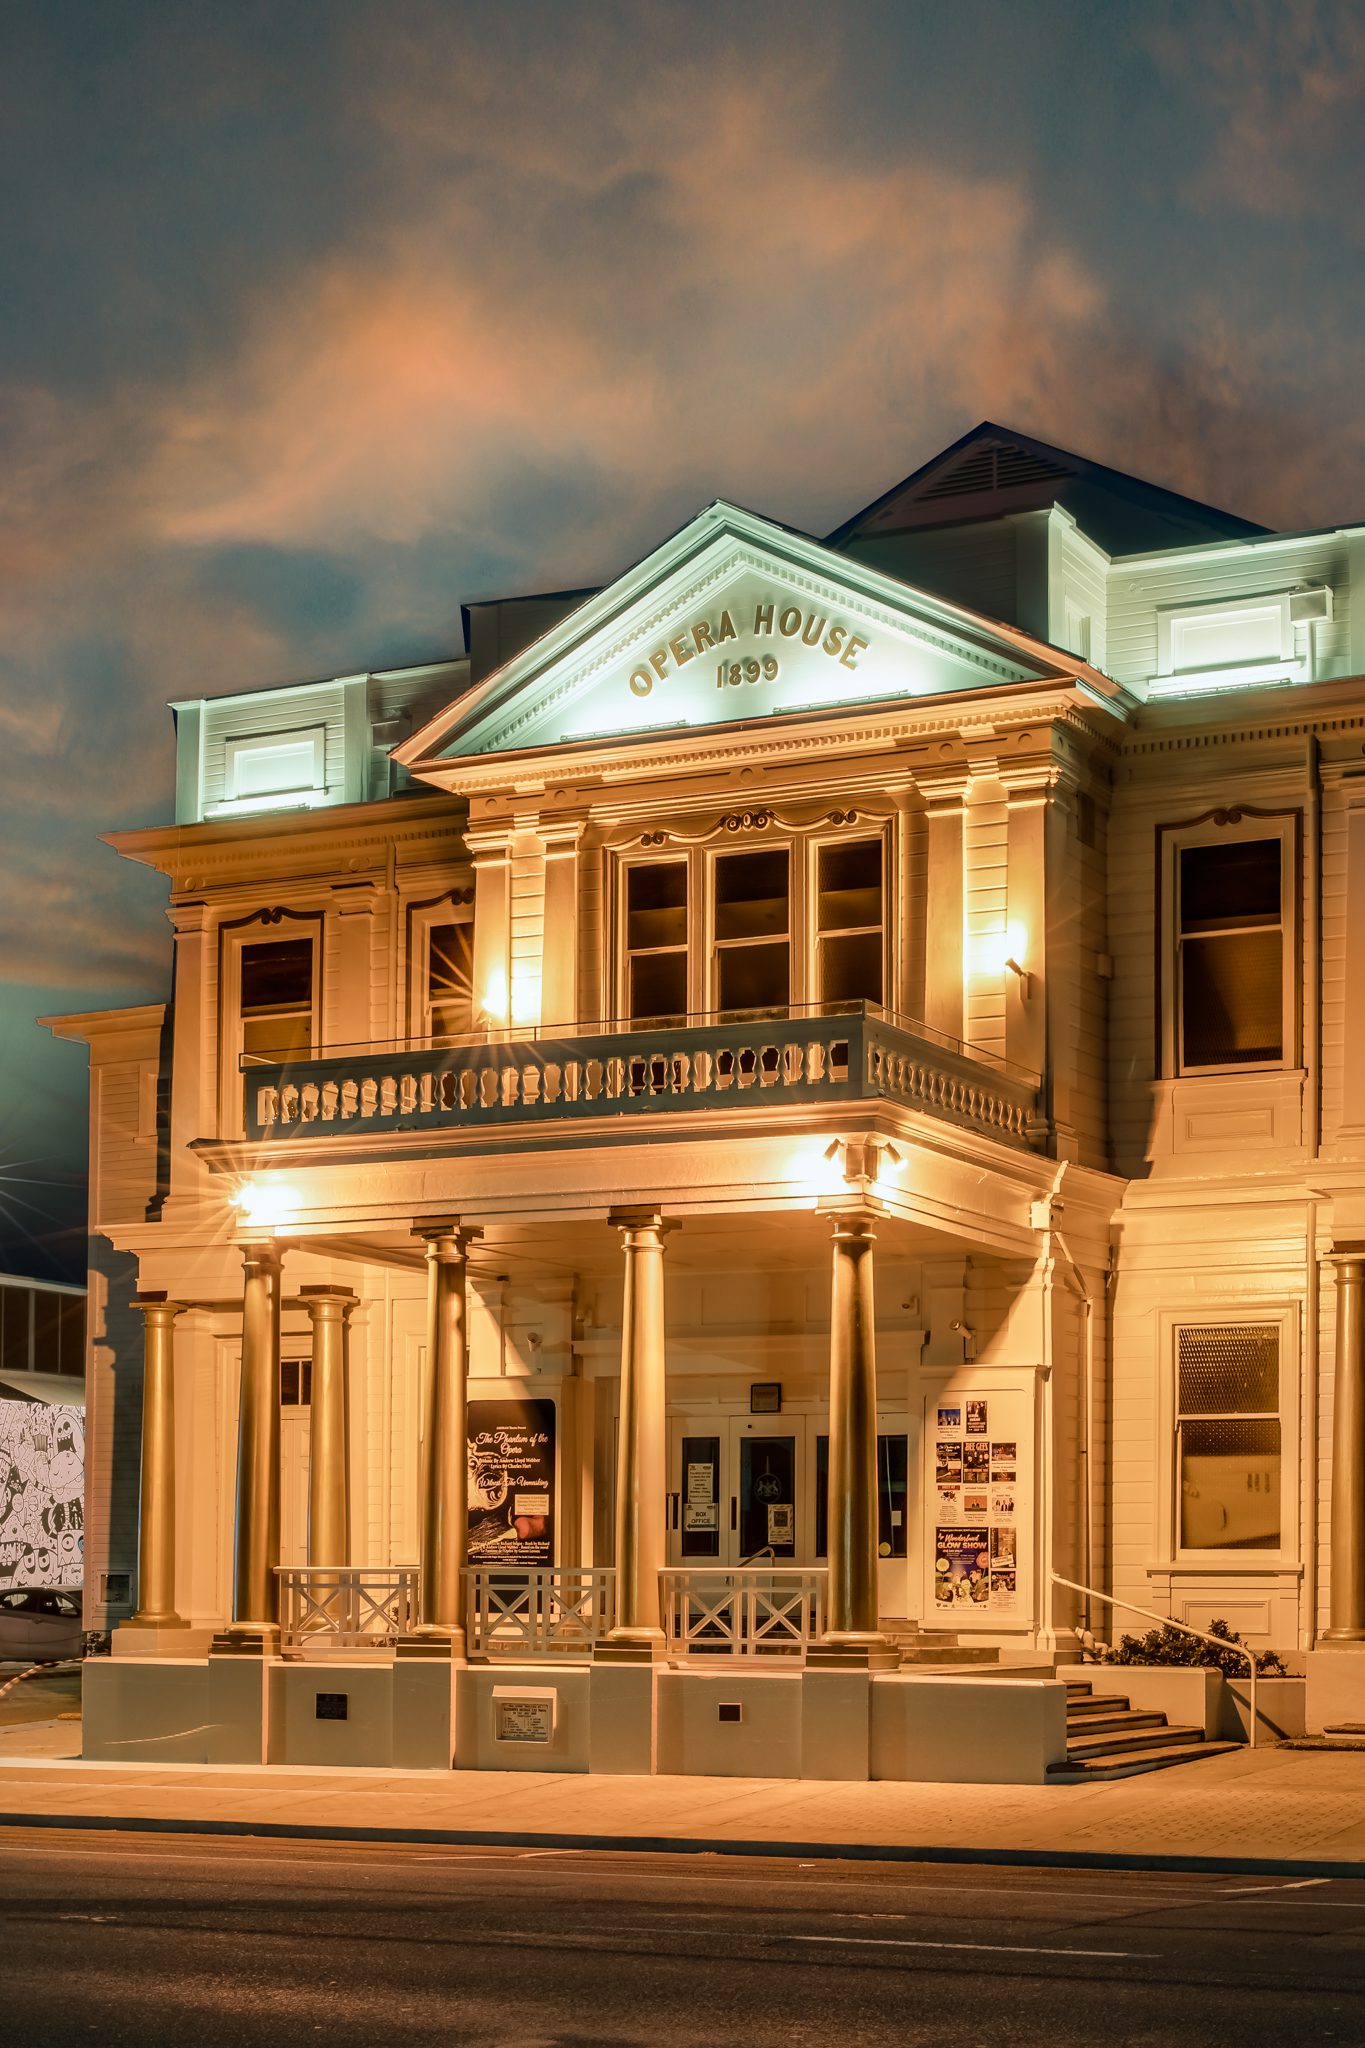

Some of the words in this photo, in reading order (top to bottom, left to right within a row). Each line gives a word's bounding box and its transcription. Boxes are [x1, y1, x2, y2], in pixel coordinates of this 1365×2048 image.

[629, 609, 738, 697] OPERA
[753, 604, 869, 671] HOUSE
[716, 658, 779, 689] 1899
[476, 1432, 493, 1445] The
[494, 1431, 528, 1444] Phantom
[529, 1433, 538, 1447] of
[538, 1433, 548, 1443] the
[500, 1442, 522, 1457] Opera
